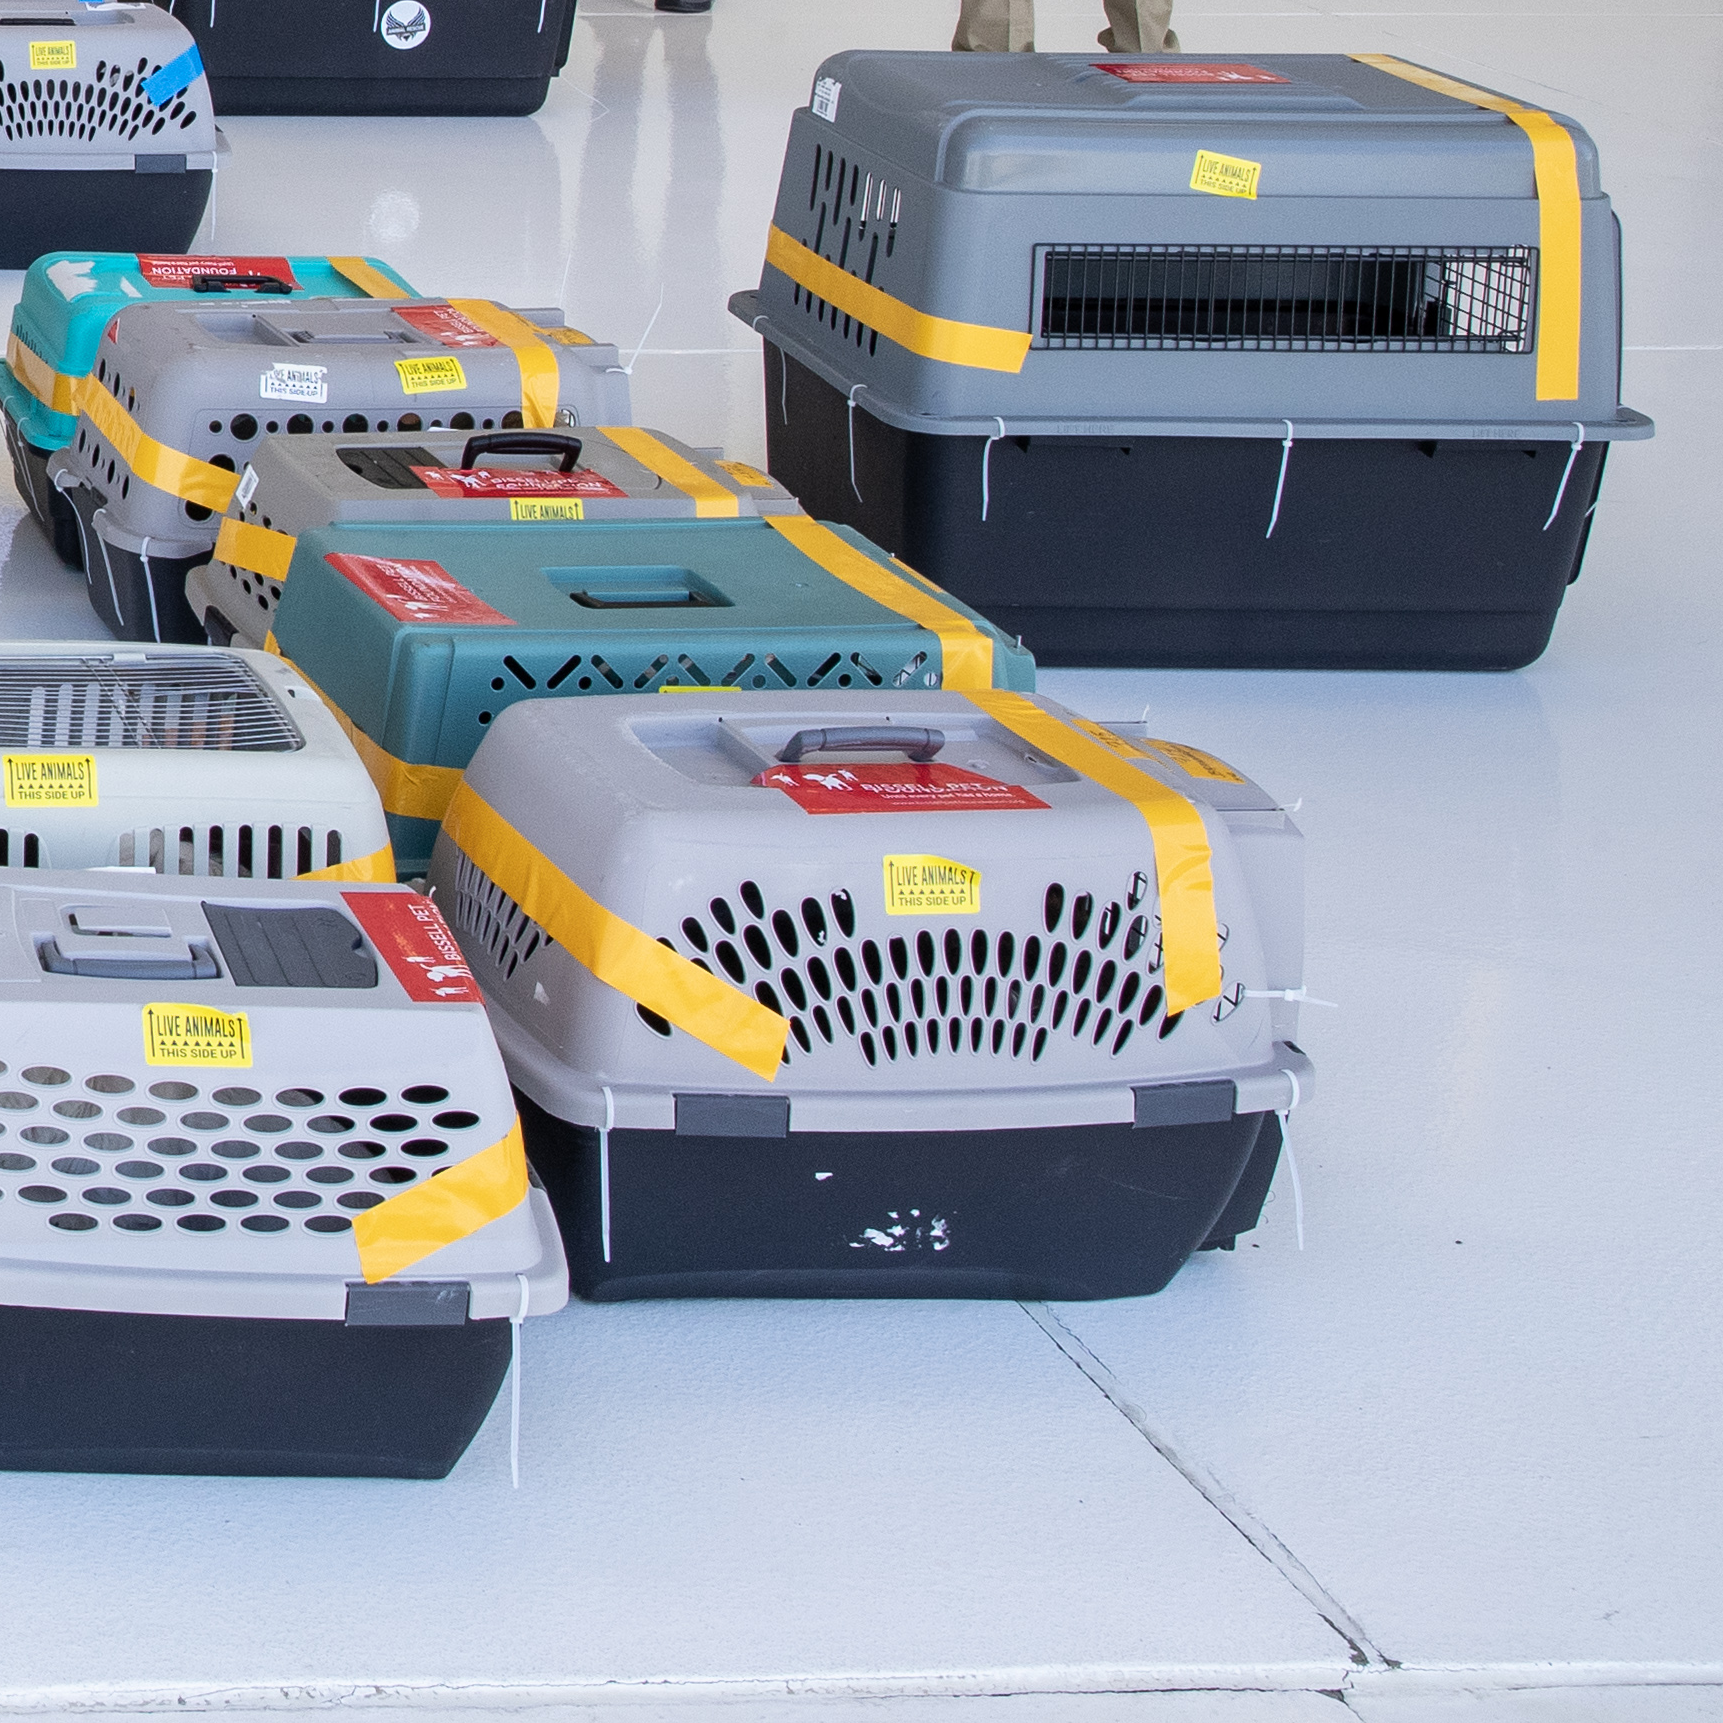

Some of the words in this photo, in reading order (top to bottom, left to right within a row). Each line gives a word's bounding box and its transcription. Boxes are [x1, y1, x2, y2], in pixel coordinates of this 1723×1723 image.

[36, 47, 46, 56] LIVE
[48, 46, 69, 56] ANIMALS
[1203, 159, 1218, 175] LIVE
[1220, 163, 1251, 183] ANIMALS
[1201, 178, 1216, 188] THIS
[1218, 182, 1234, 192] SIDE
[152, 267, 237, 275] FOUNDATION
[404, 363, 422, 376] LIVE
[423, 361, 453, 375] ANIMALS
[411, 380, 428, 388] THIS
[289, 388, 305, 396] SIDE
[520, 504, 537, 519] LIVE
[540, 504, 573, 520] ANIMALS
[16, 762, 37, 780] LIVE
[41, 762, 85, 780] ANIMALS
[18, 791, 42, 799] THIS
[45, 791, 69, 799] SIDE
[71, 791, 85, 799] UP
[897, 866, 917, 886] LIVE
[922, 865, 966, 886] ANIMALS
[898, 896, 922, 906] THIS
[925, 896, 949, 906] SIDE
[952, 896, 966, 906] UP
[407, 904, 434, 922] PET
[424, 923, 461, 961] BISSELL
[157, 1015, 181, 1037] LIVE
[186, 1016, 235, 1038] ANIMALS
[159, 1048, 187, 1058] THIS
[191, 1049, 217, 1058] SIDE
[221, 1049, 237, 1059] UP
